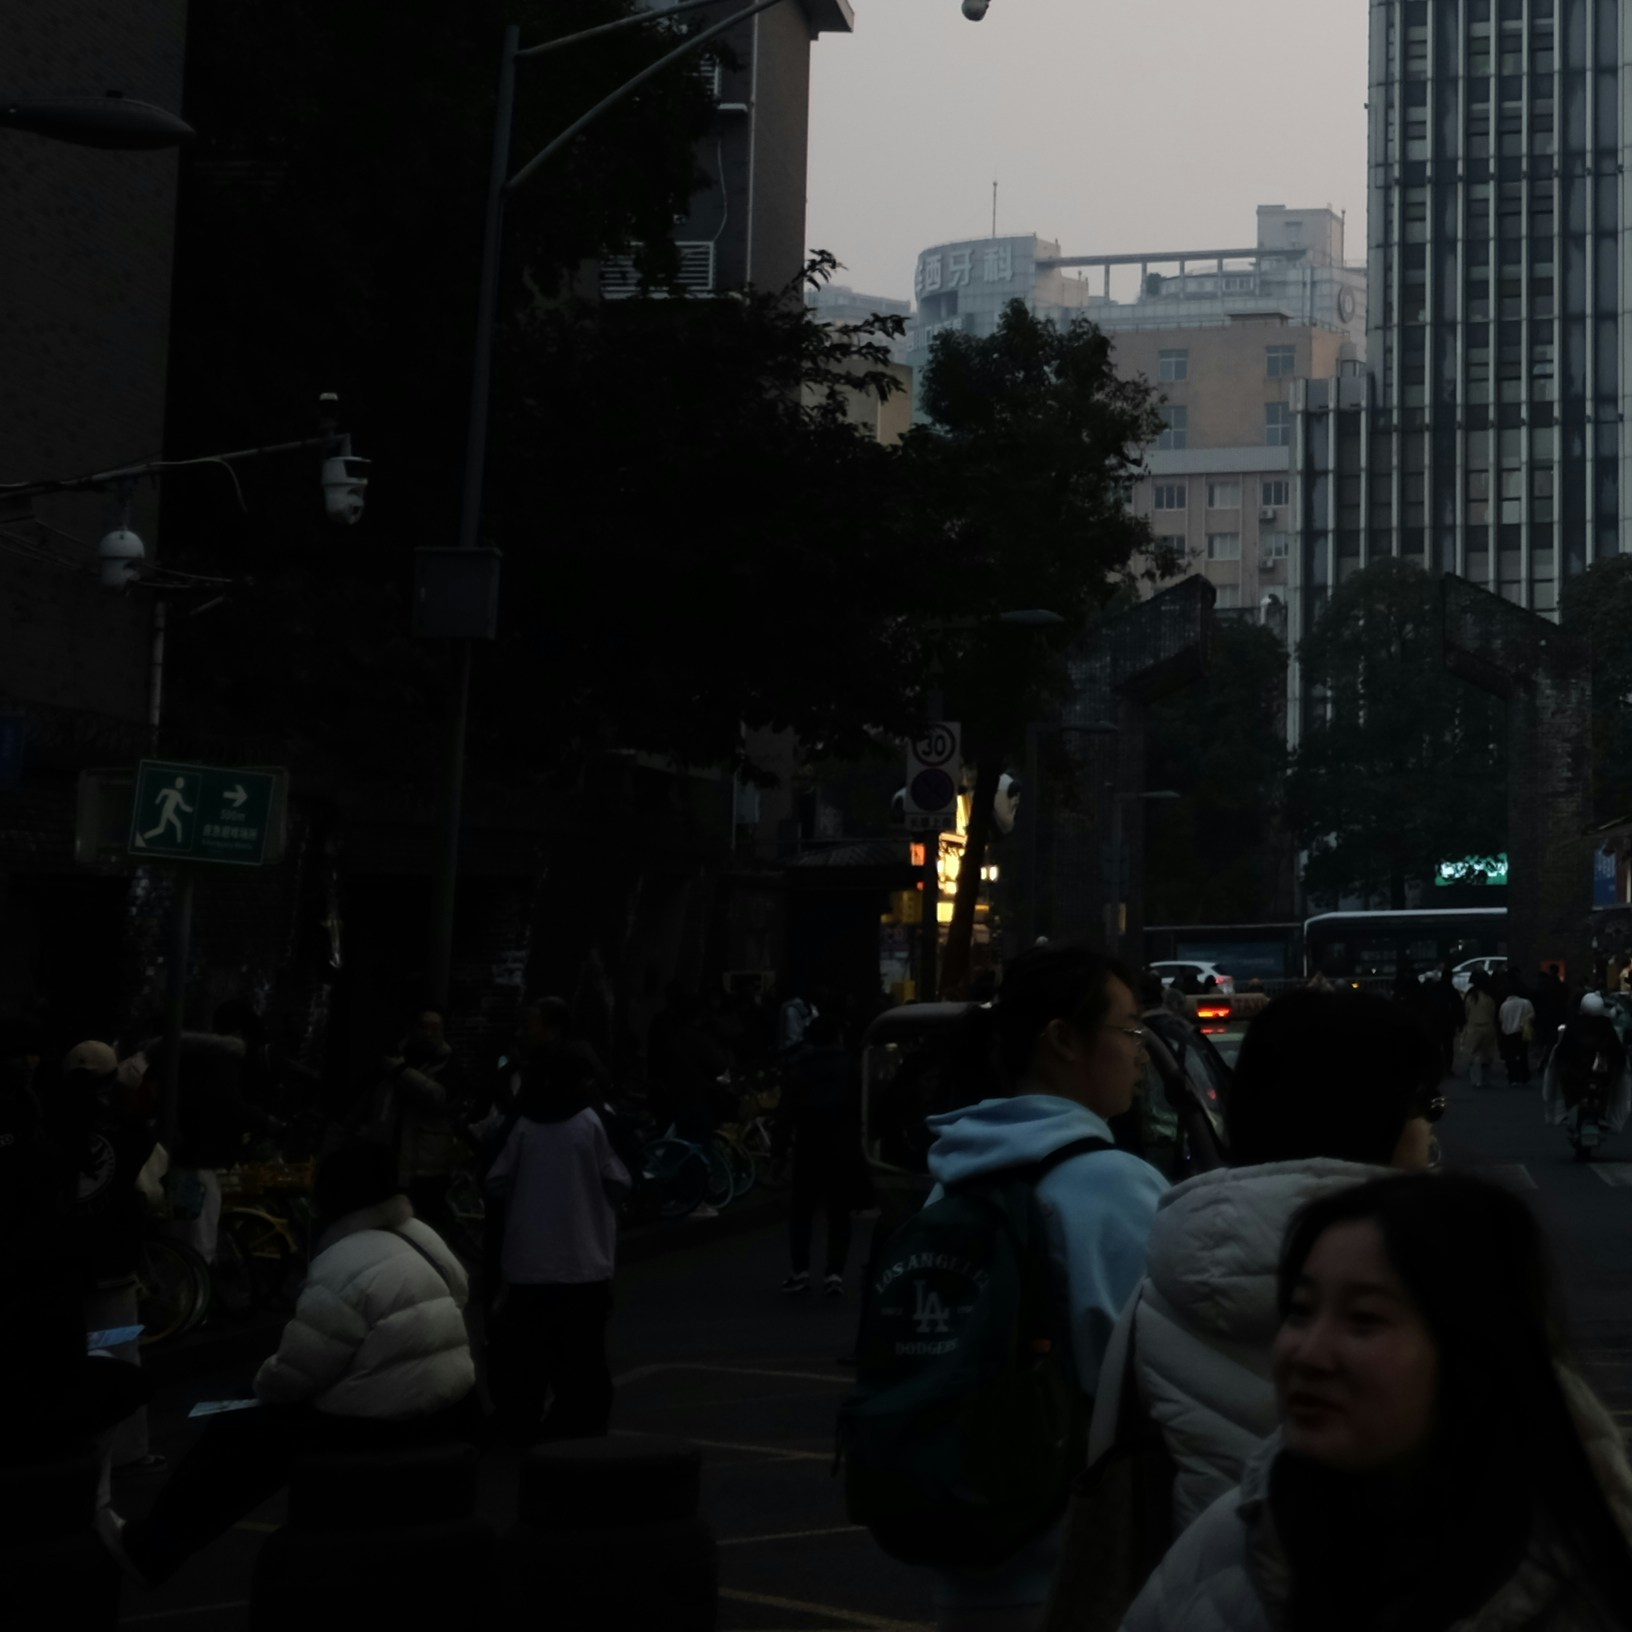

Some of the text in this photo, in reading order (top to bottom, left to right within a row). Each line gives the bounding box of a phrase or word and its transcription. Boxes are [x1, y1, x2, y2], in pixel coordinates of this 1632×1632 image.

[921, 734, 946, 757] 30
[874, 1260, 906, 1296] LOS
[911, 1279, 951, 1334] LA
